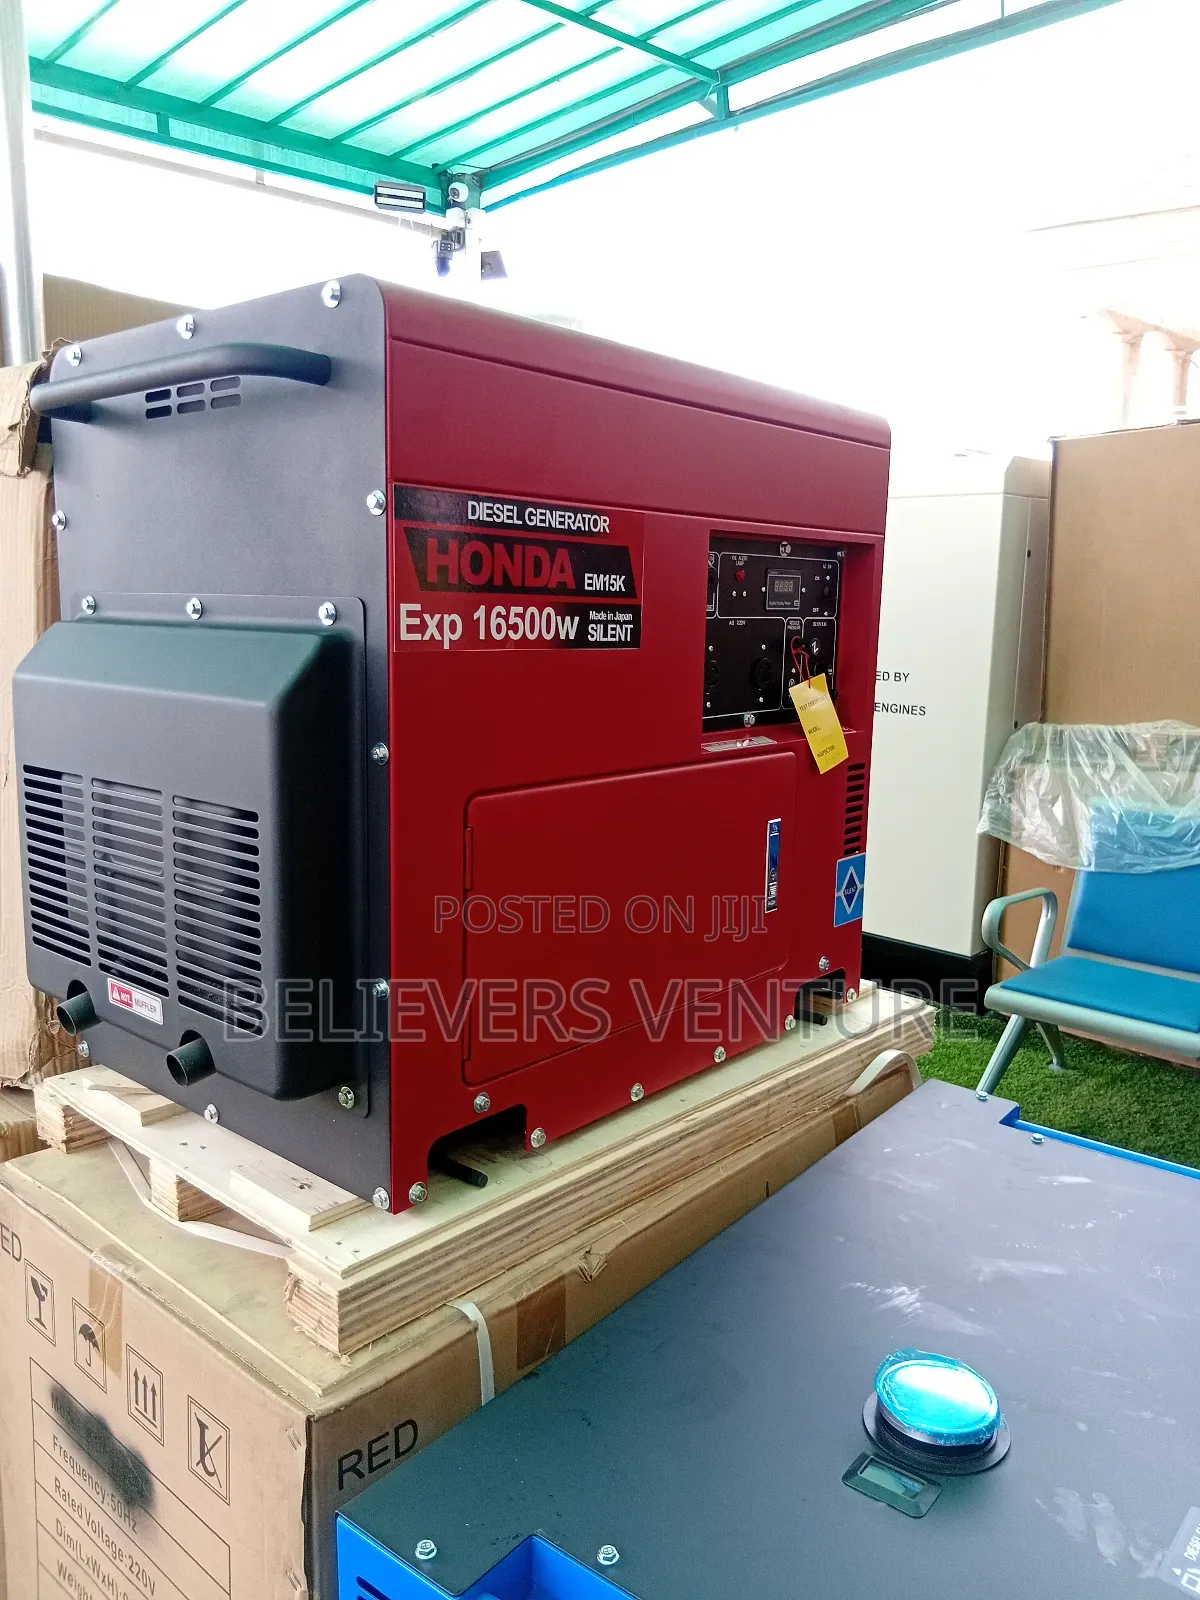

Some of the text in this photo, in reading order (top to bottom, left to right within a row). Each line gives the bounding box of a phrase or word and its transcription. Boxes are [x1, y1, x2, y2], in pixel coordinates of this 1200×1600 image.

[467, 500, 610, 533] DIESEL GENERATOR
[426, 537, 576, 589] HONDA
[584, 573, 625, 591] EM15K
[589, 611, 633, 622] Made in Japan
[400, 603, 579, 649] Exp 16500w
[587, 624, 634, 642] SILENT
[894, 672, 910, 683] BY
[874, 702, 926, 716] ENGINES
[844, 885, 857, 896] SILENT
[134, 998, 157, 1012] MUFFLER
[337, 1418, 419, 1491] RED
[52, 1433, 138, 1535] Frequency:50Hz
